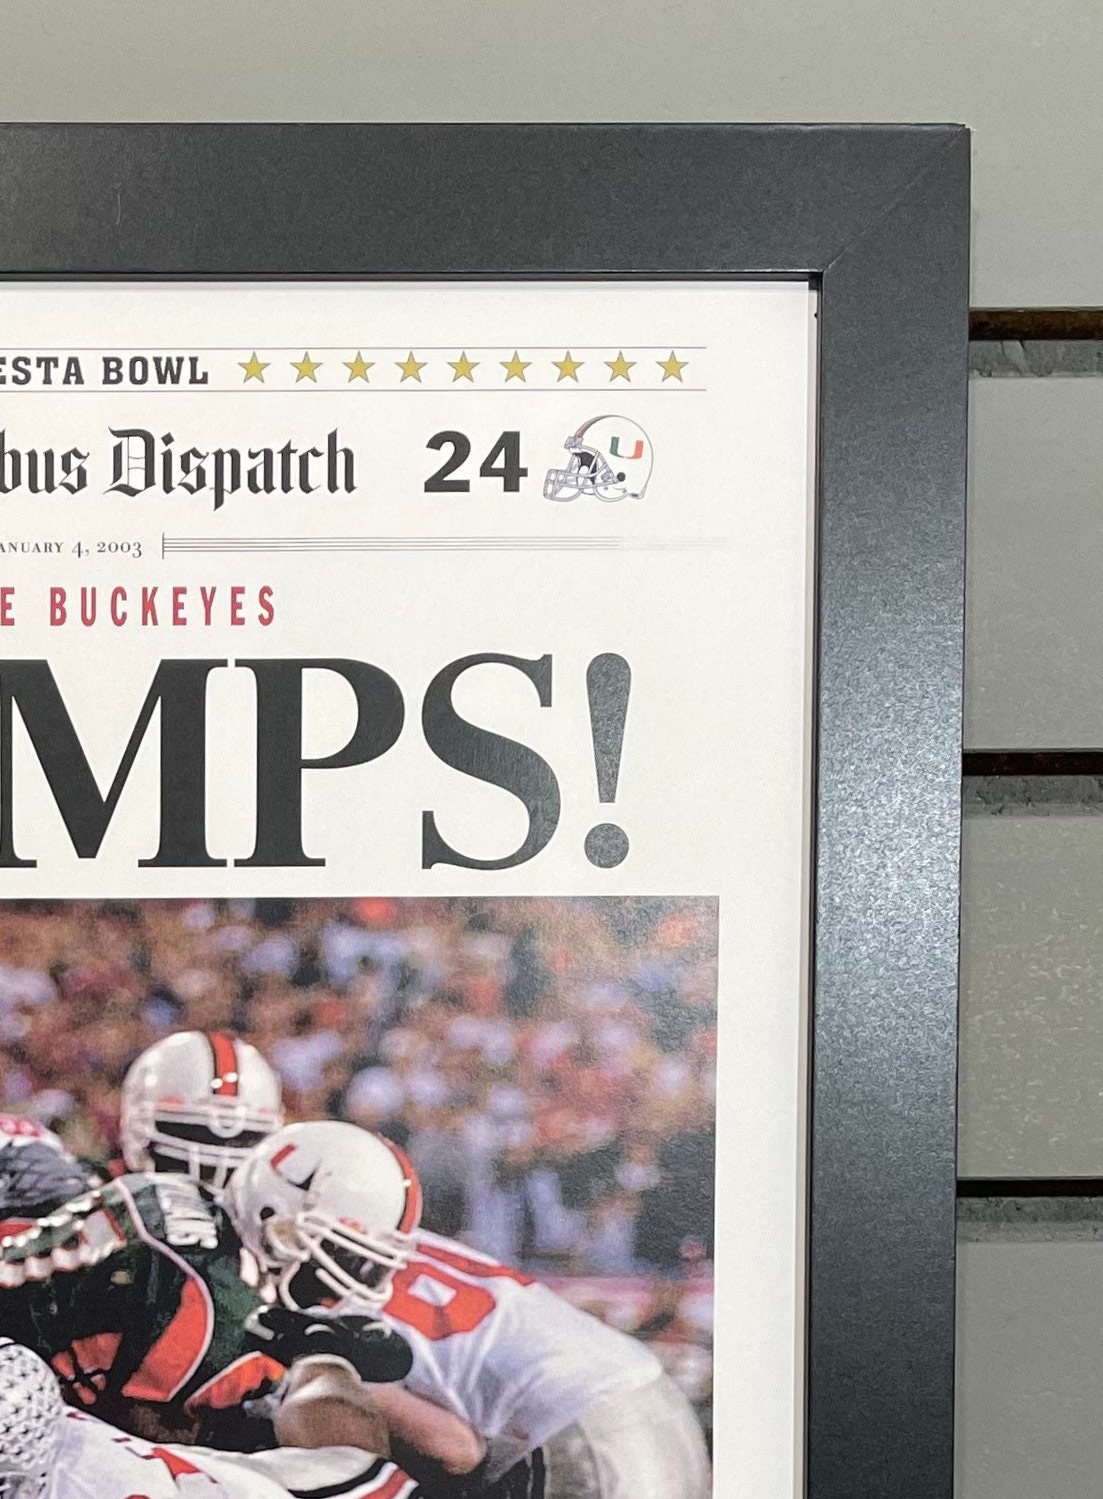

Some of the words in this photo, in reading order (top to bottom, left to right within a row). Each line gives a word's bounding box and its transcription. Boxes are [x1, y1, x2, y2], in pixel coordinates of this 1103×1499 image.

[101, 355, 209, 386] BOWL
[104, 426, 358, 512] Dispatch
[423, 430, 529, 494] 24
[96, 541, 143, 559] 2003
[49, 585, 275, 628] BUCKEYES
